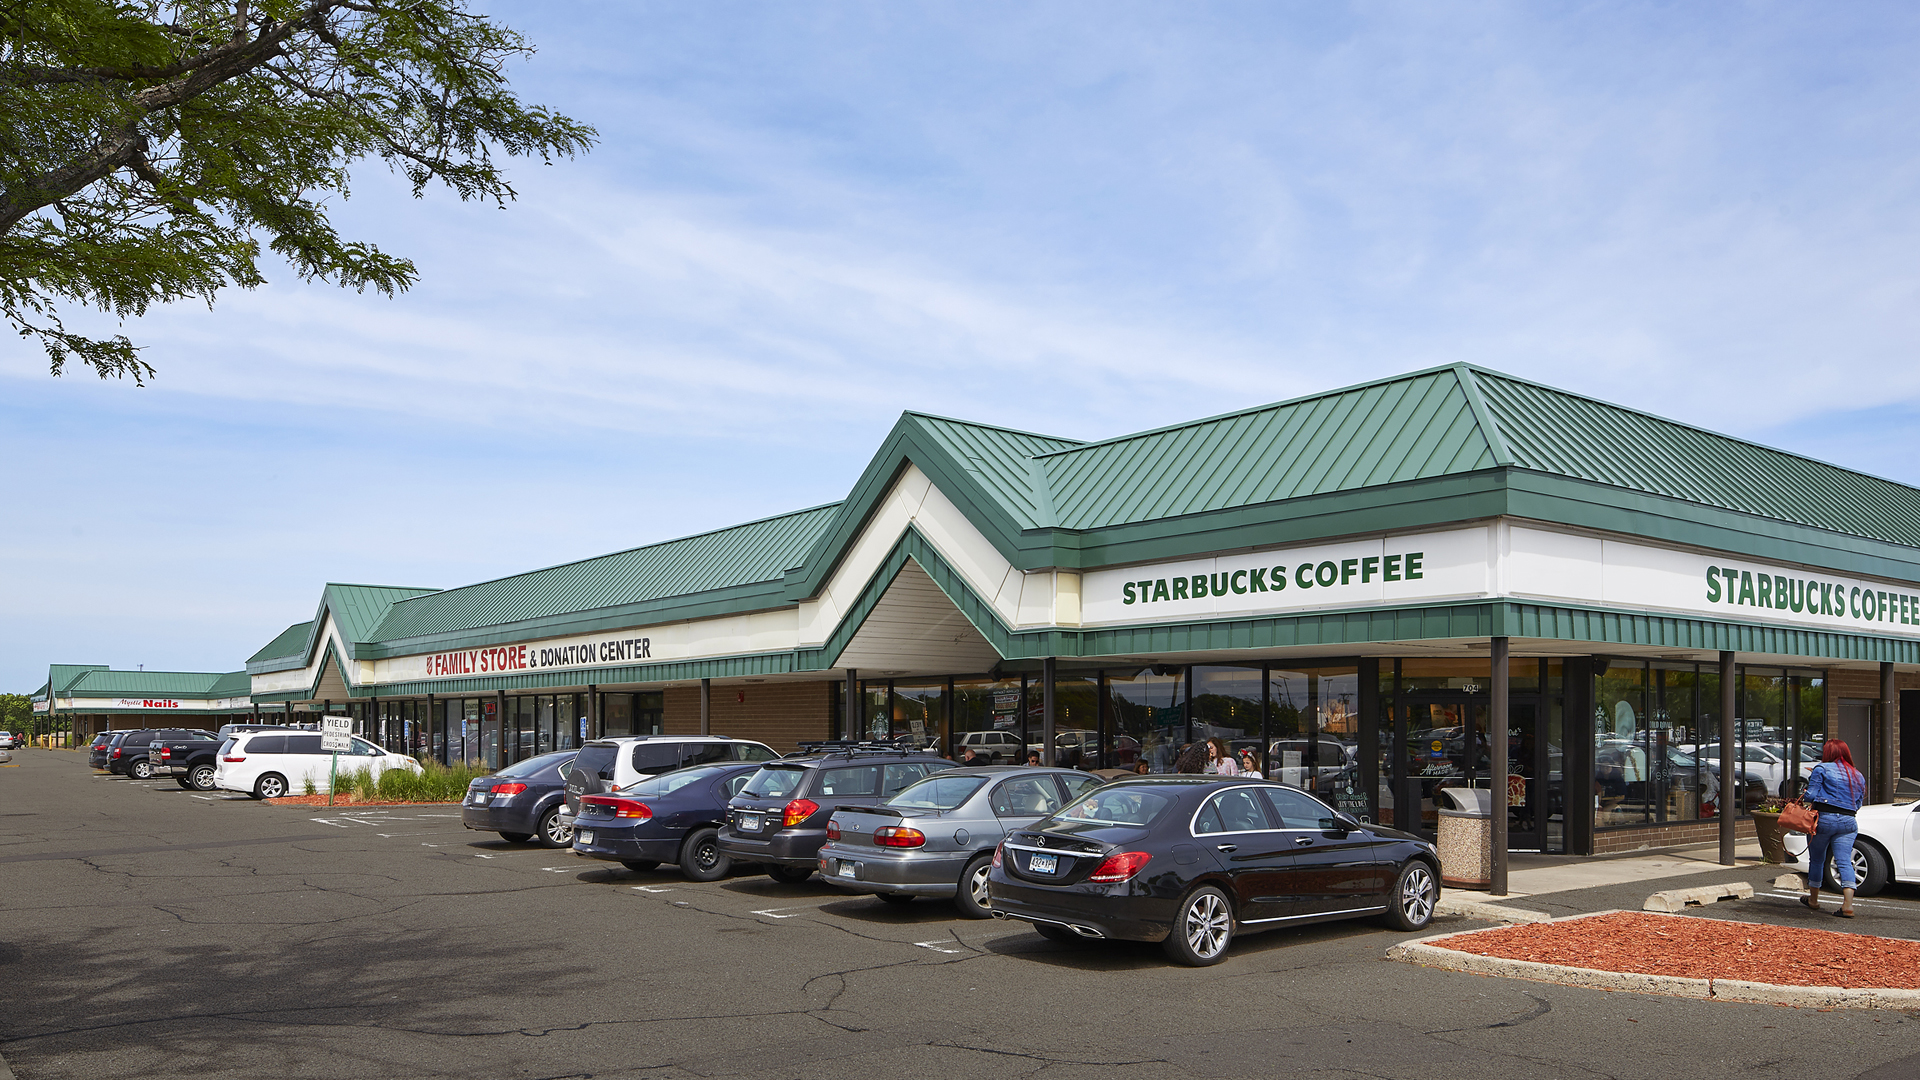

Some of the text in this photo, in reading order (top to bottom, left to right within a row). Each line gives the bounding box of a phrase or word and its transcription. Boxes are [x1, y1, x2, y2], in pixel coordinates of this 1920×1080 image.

[1122, 552, 1424, 605] STARBUCKS COFFEE
[1706, 565, 1920, 626] STARBUCKS COFFEE
[435, 650, 478, 675] FAMILY
[481, 645, 527, 672] STORE
[530, 650, 537, 668] &
[541, 643, 596, 667] DONATION
[600, 637, 651, 662] CENTER
[1463, 684, 1478, 692] 704
[118, 699, 179, 708] Mystic Nails
[326, 719, 350, 728] YIELD
